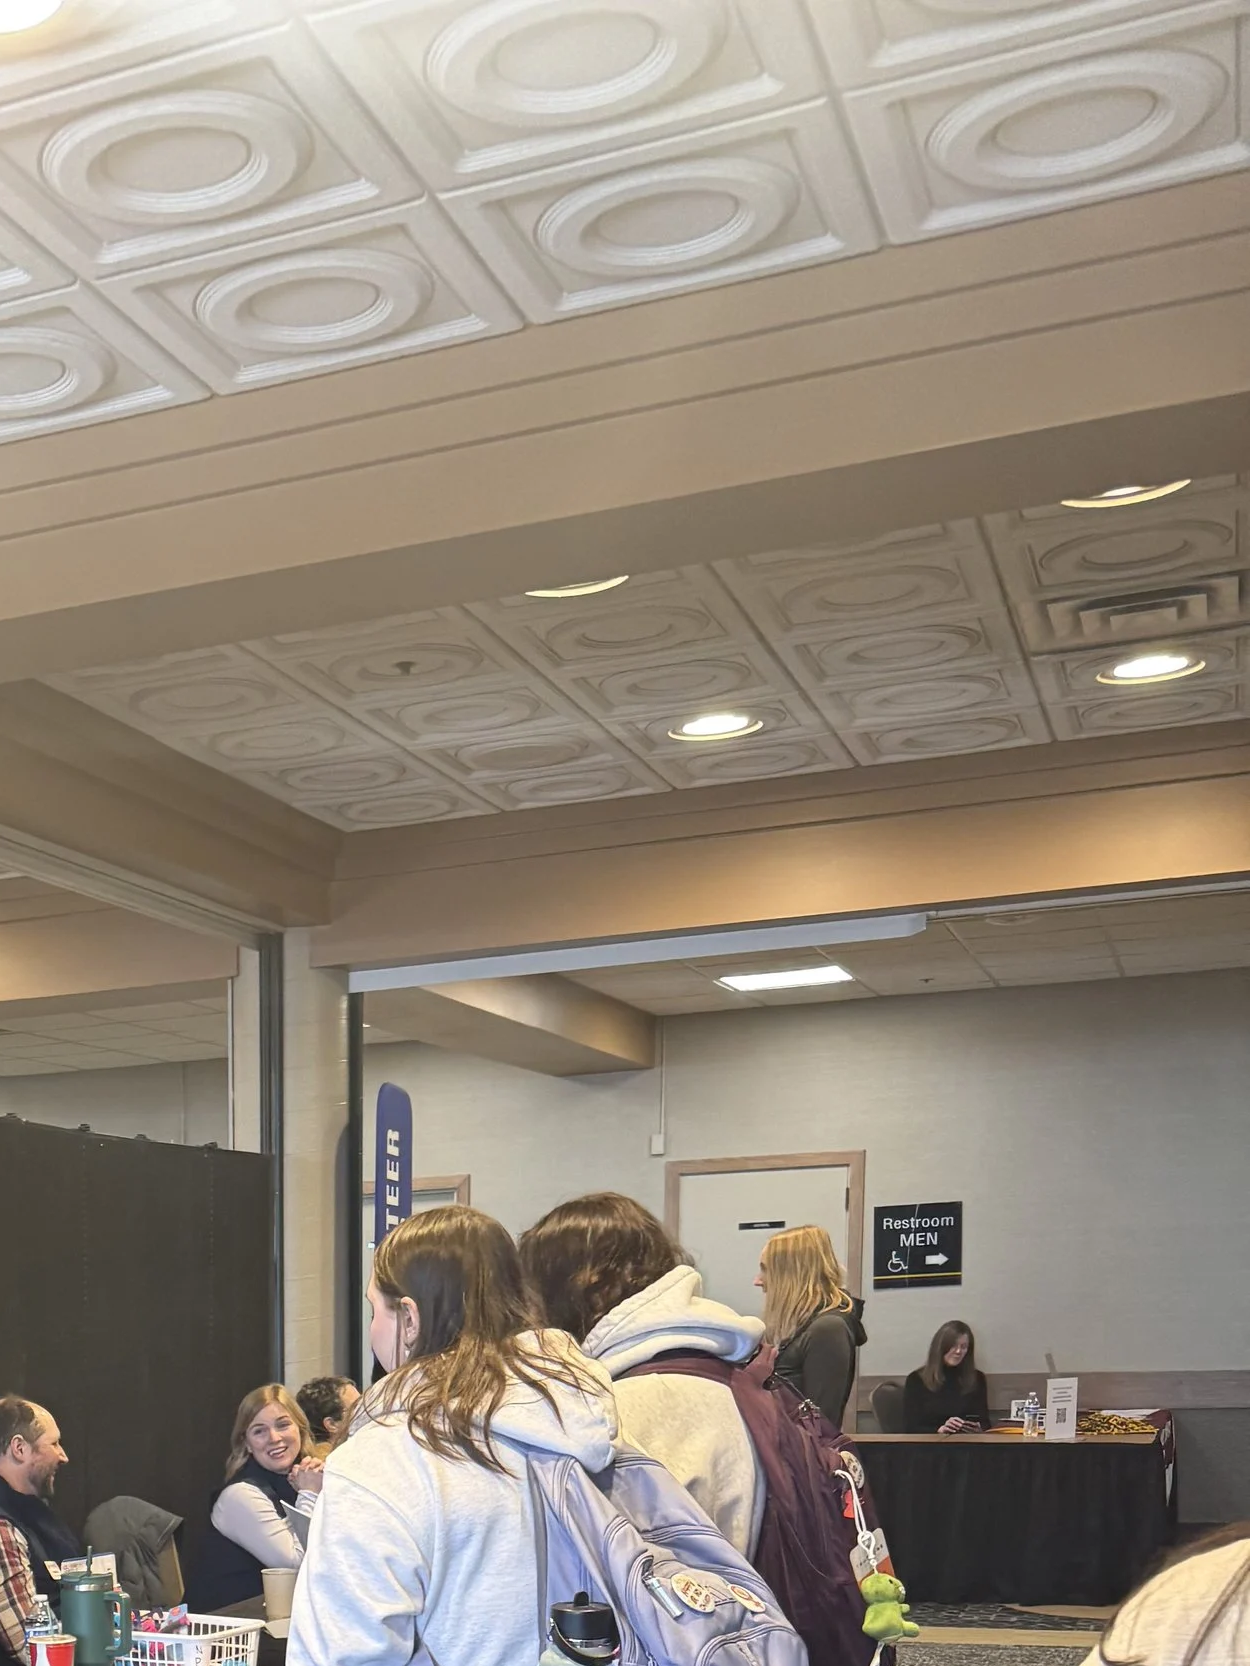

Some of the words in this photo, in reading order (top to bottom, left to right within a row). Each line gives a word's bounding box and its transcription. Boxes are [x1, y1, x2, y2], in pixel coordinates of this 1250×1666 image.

[386, 1129, 399, 1232] TEER
[883, 1216, 954, 1230] Restroom
[900, 1232, 938, 1247] MEN
